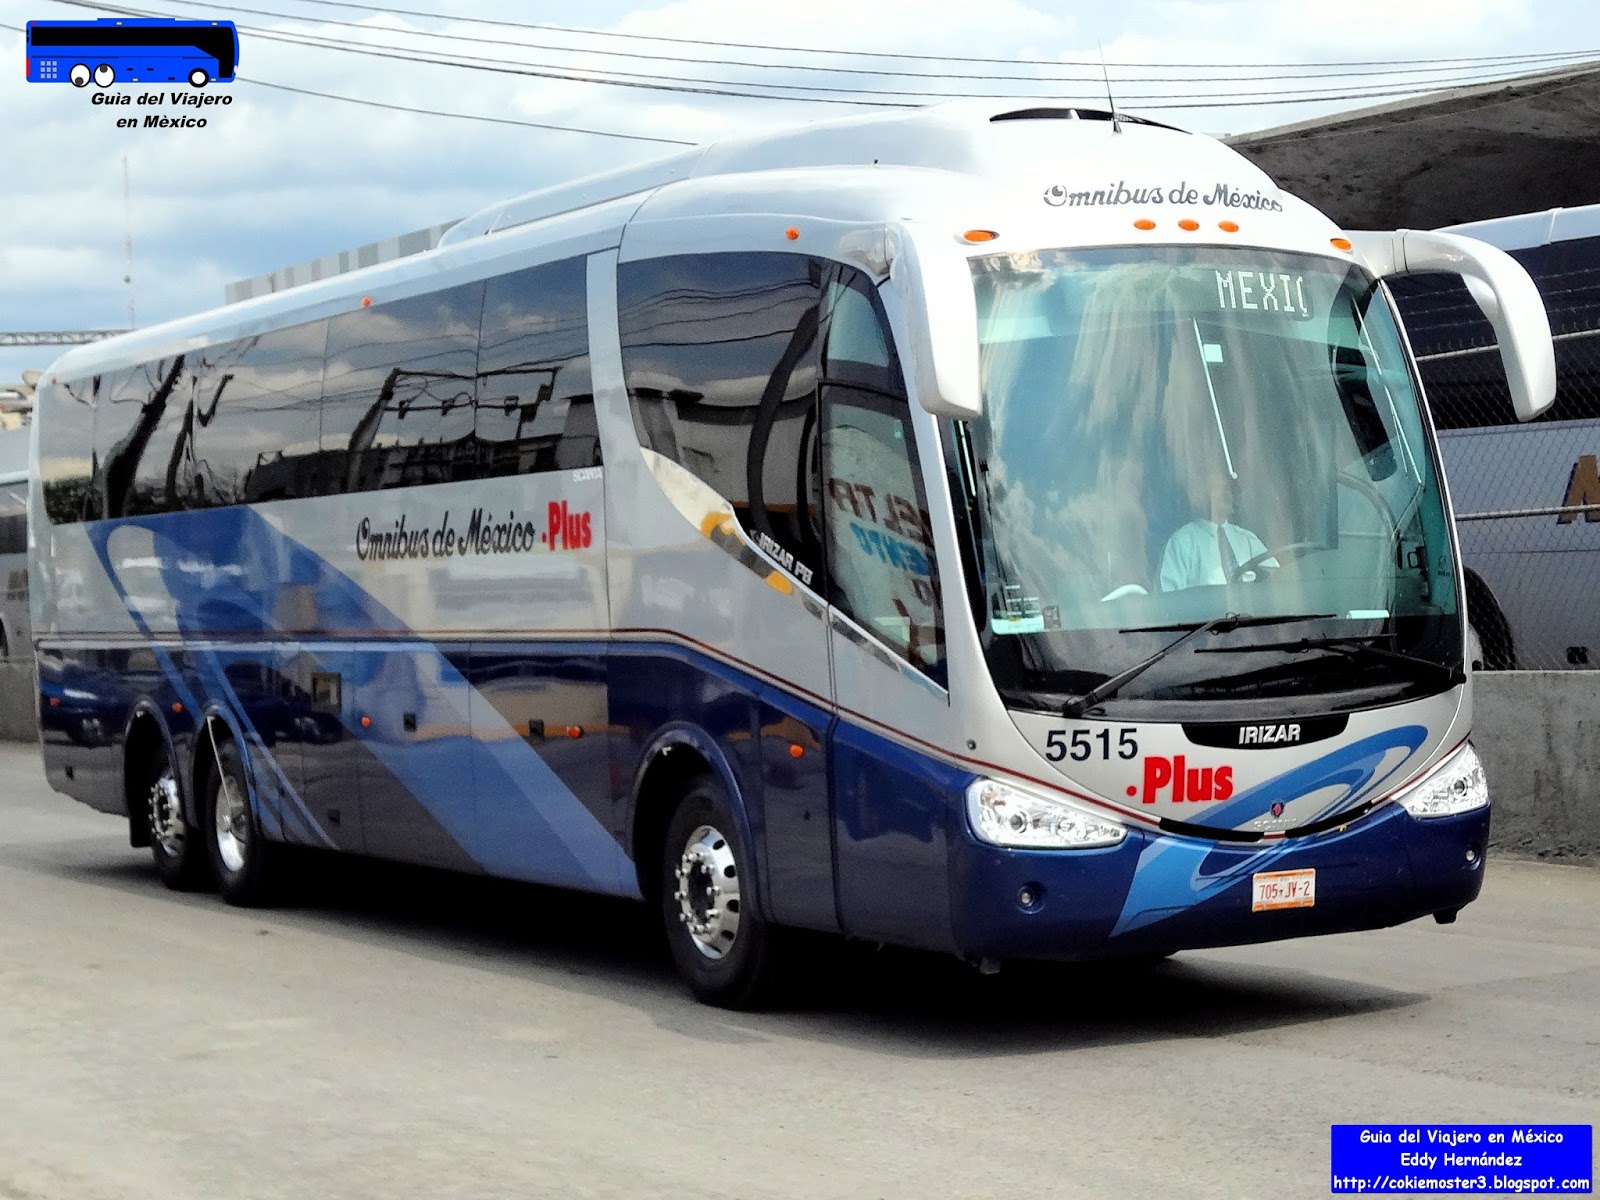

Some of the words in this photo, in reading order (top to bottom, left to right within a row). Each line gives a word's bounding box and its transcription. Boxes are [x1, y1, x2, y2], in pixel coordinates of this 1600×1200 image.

[1043, 180, 1164, 207] Omnibus
[1168, 181, 1199, 206] de
[1202, 183, 1283, 212] México
[356, 514, 430, 560] Omnibus
[432, 510, 456, 557] de
[457, 507, 536, 556] México
[758, 531, 794, 571] IRIZAR
[1045, 728, 1138, 762] 5515
[1238, 724, 1301, 745] IRIZAR
